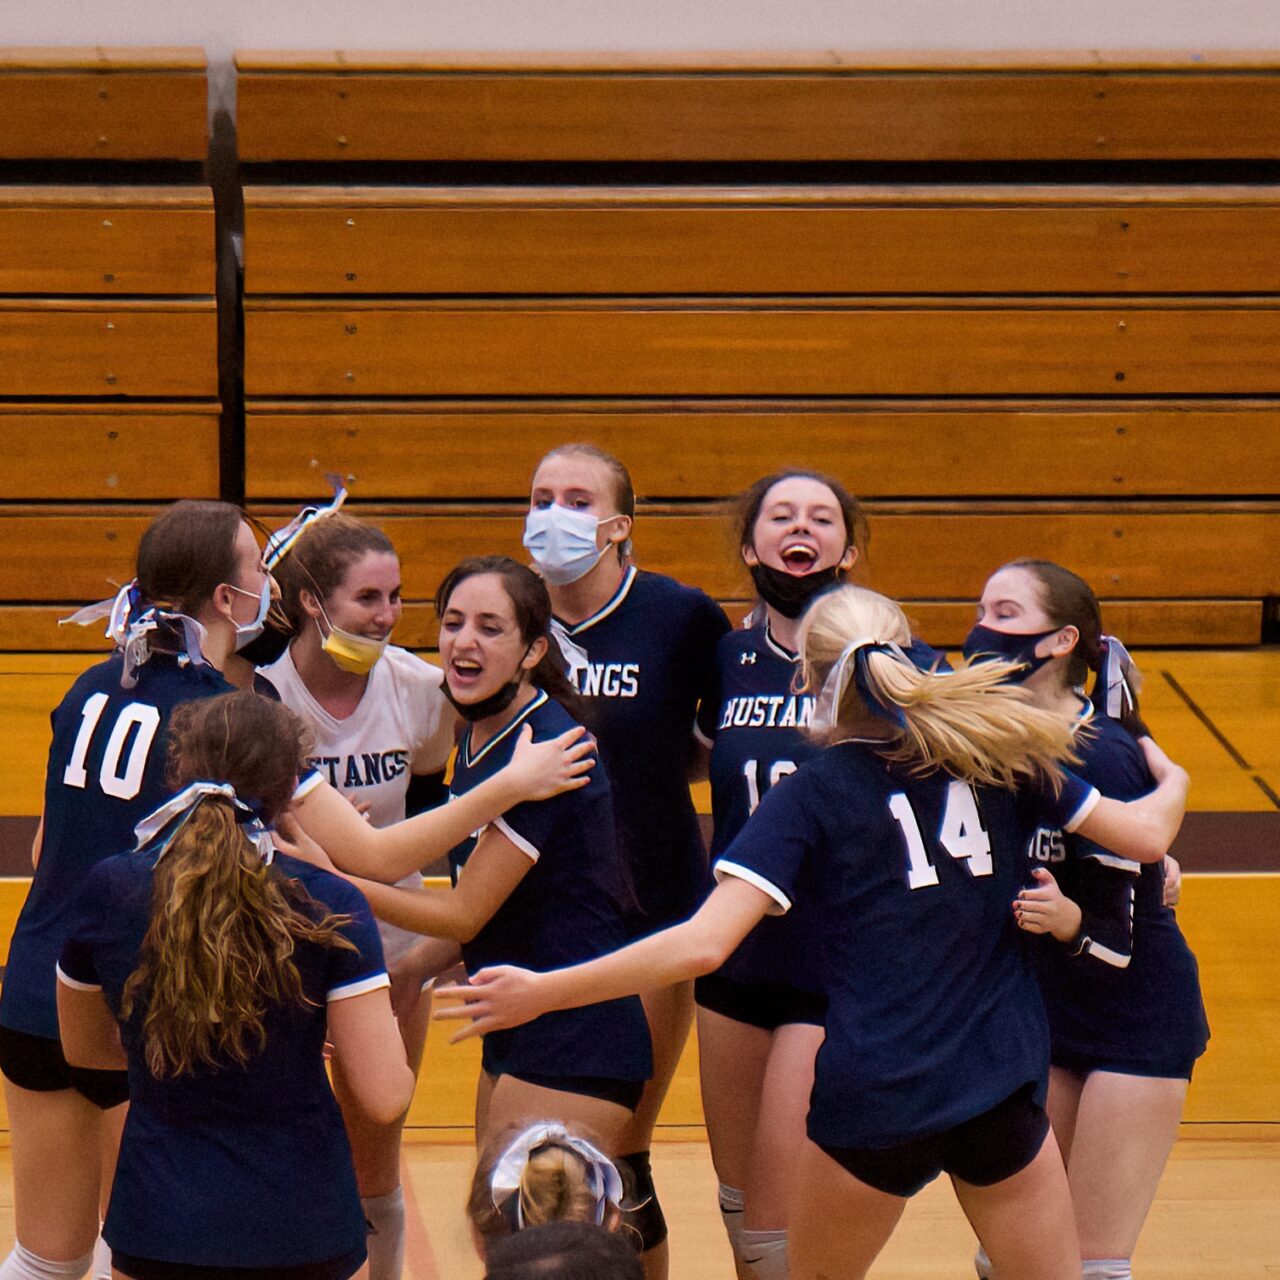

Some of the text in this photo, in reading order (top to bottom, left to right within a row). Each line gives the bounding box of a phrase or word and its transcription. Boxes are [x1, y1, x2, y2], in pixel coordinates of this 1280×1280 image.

[63, 692, 160, 800] 10
[720, 695, 818, 729] MUSTAN
[889, 781, 993, 890] 14
[1028, 828, 1066, 862] GS
